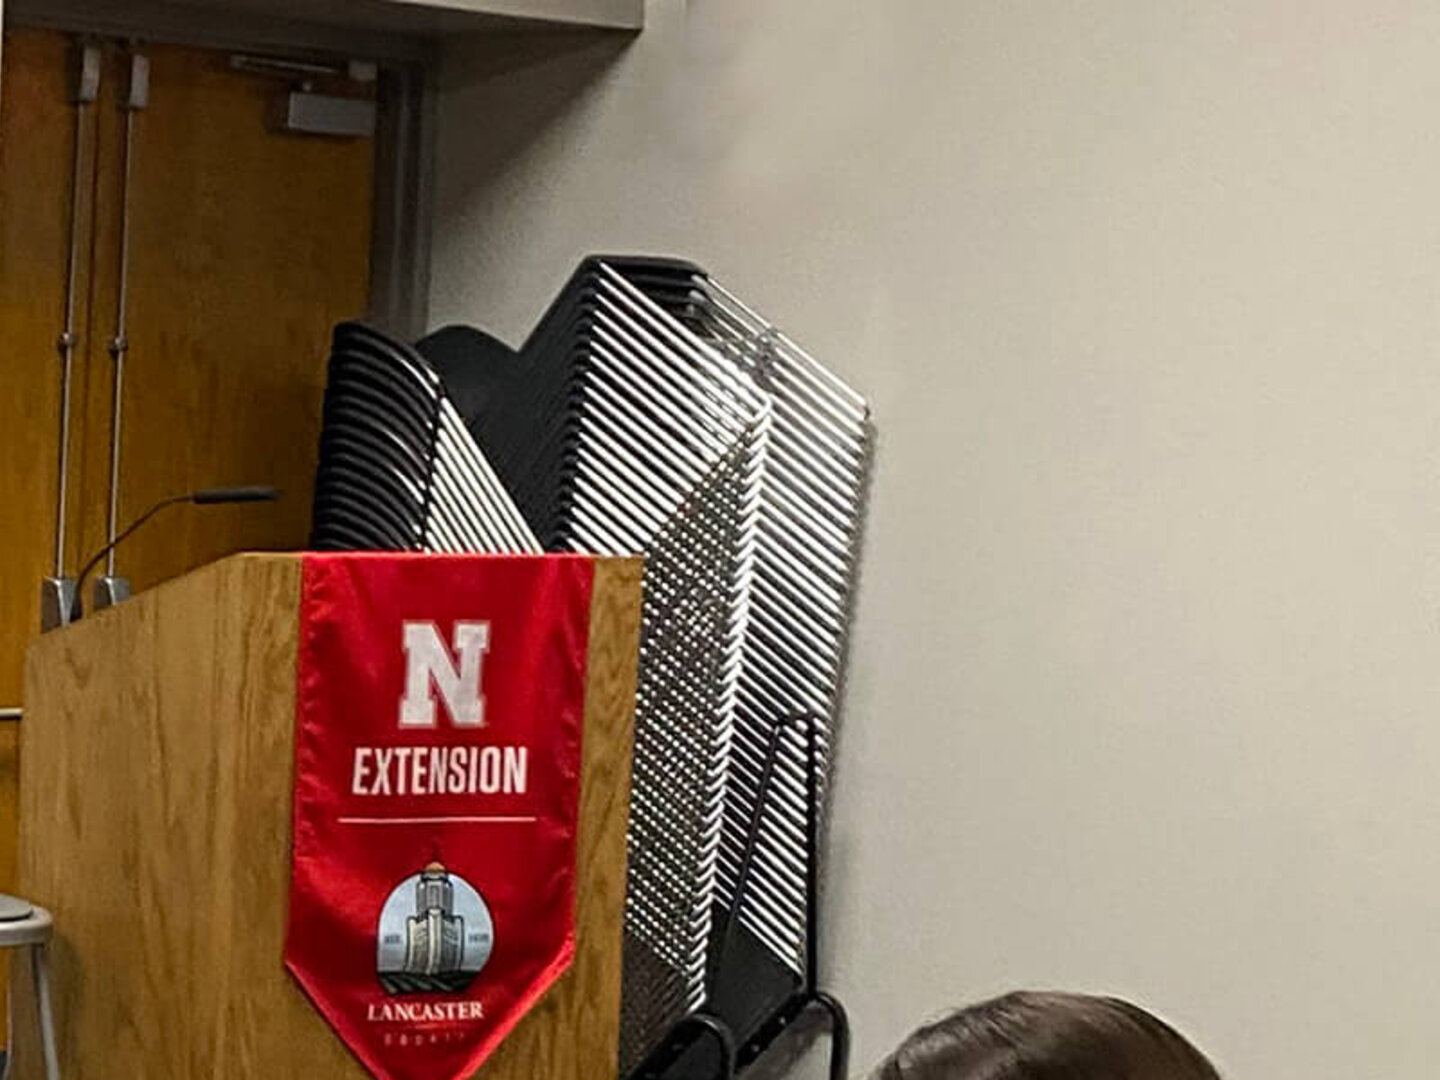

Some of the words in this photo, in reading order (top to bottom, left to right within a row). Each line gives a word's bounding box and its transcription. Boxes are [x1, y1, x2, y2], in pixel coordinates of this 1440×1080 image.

[398, 620, 490, 728] N
[352, 746, 528, 796] EXTENSION
[368, 1001, 484, 1021] LANCASTER
